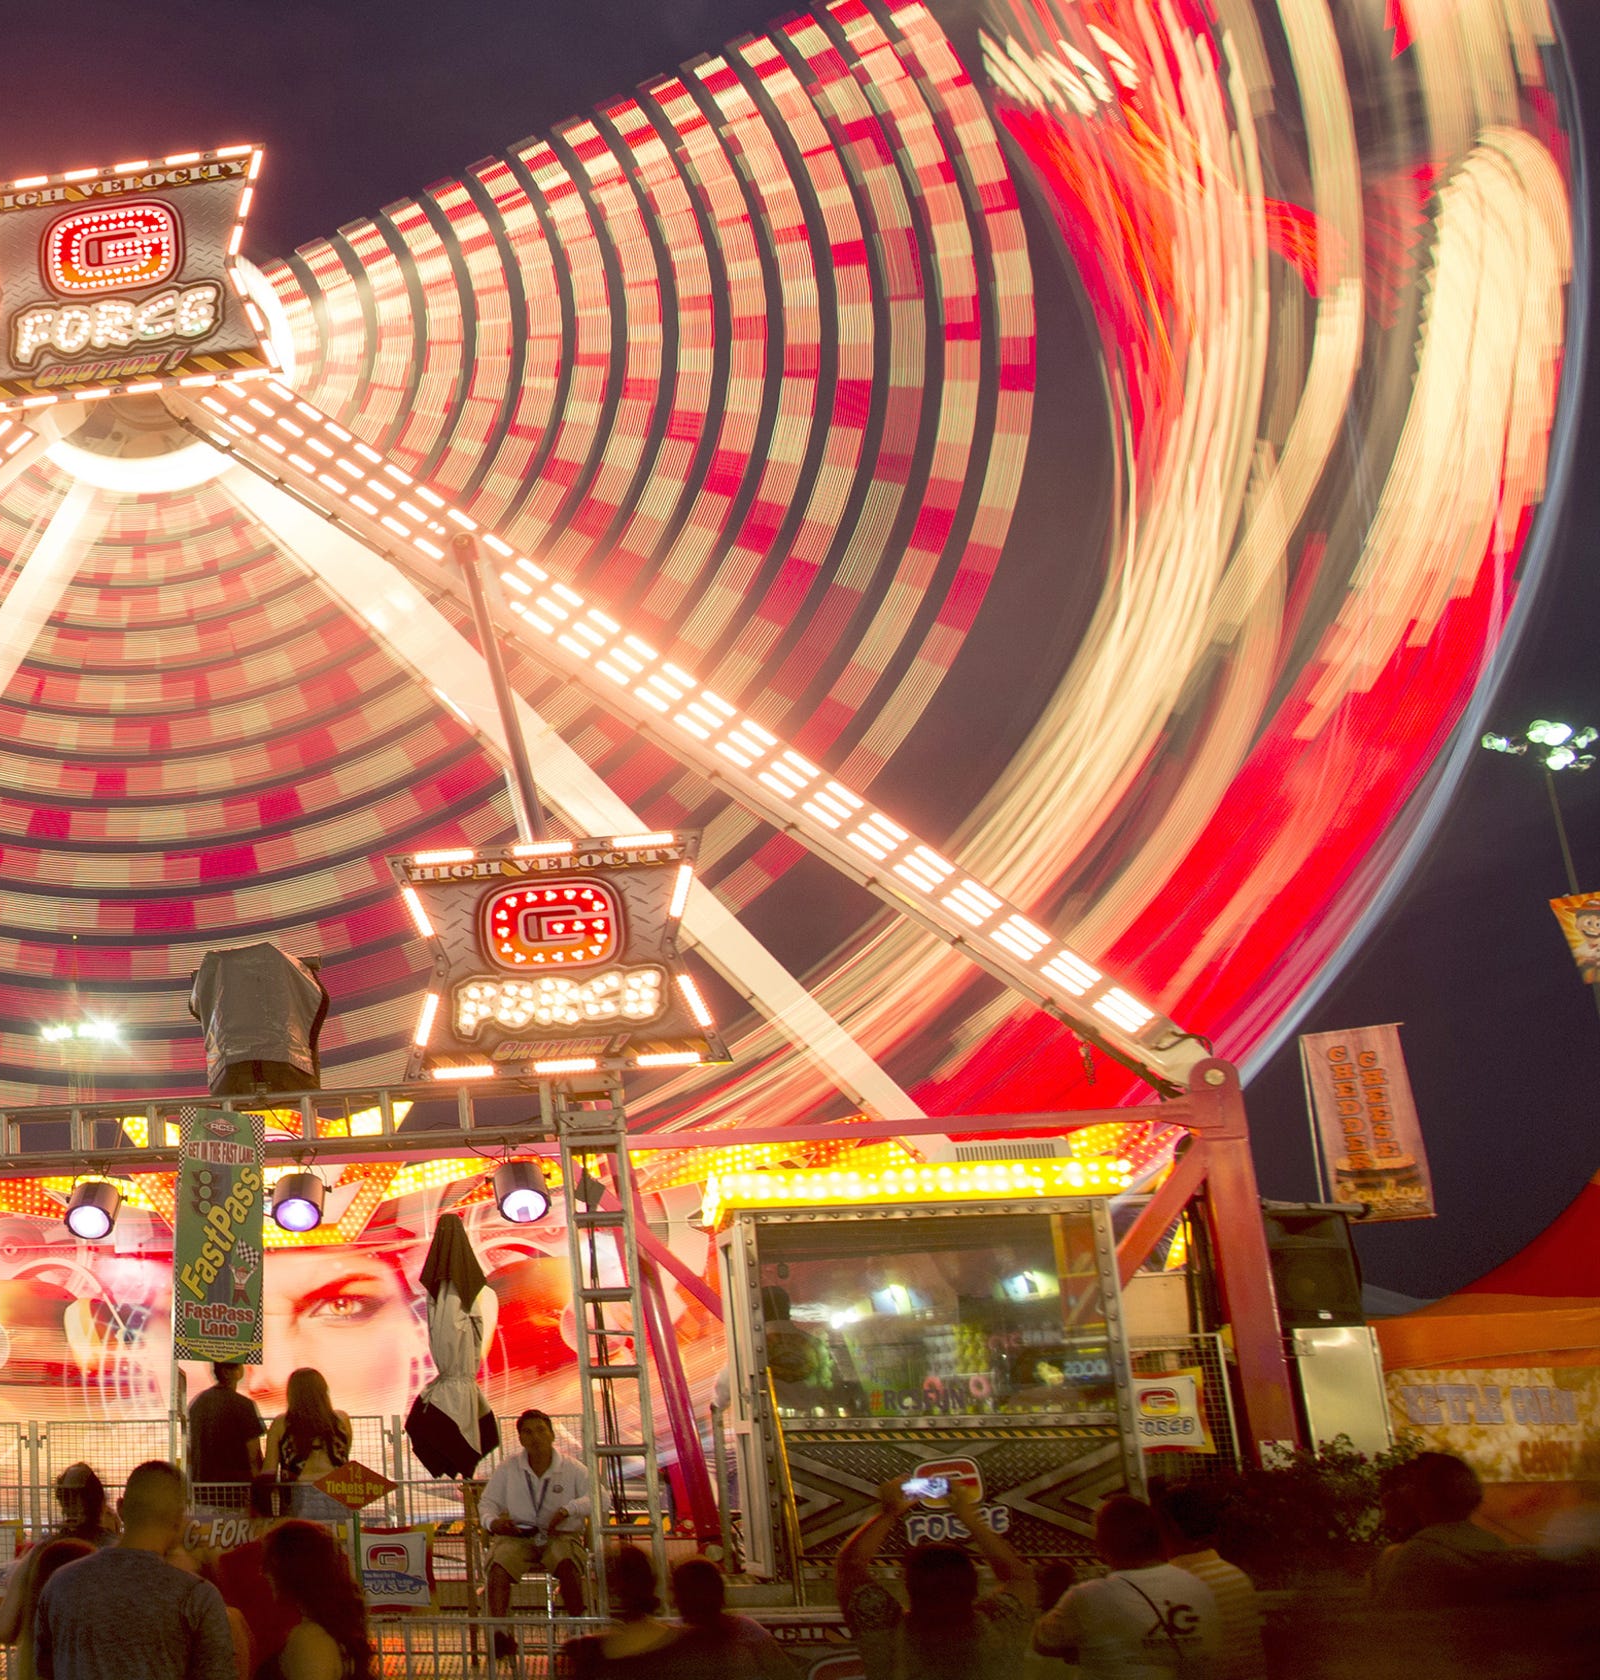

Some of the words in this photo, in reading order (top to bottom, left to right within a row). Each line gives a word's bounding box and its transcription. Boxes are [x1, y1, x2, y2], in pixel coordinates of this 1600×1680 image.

[77, 159, 249, 197] VELOCITY
[45, 200, 177, 295] G
[13, 288, 220, 365] FORCE
[410, 863, 501, 882] HIGH
[513, 848, 684, 873] VELOCITY
[485, 878, 618, 971] G
[458, 969, 662, 1037] FORCE
[188, 1141, 200, 1159] GET
[209, 1141, 221, 1162] THE
[222, 1142, 238, 1164] FAST
[239, 1145, 254, 1164] LANE
[180, 1167, 261, 1300] FastPass
[184, 1300, 255, 1324] FastPass
[200, 1318, 238, 1338] Lane
[1137, 1386, 1179, 1418] G
[1137, 1415, 1195, 1437] ORCE
[325, 1479, 365, 1495] Tickets
[365, 1481, 385, 1495] Per
[184, 1518, 258, 1551] G-FORC
[904, 1504, 1010, 1547] FORE
